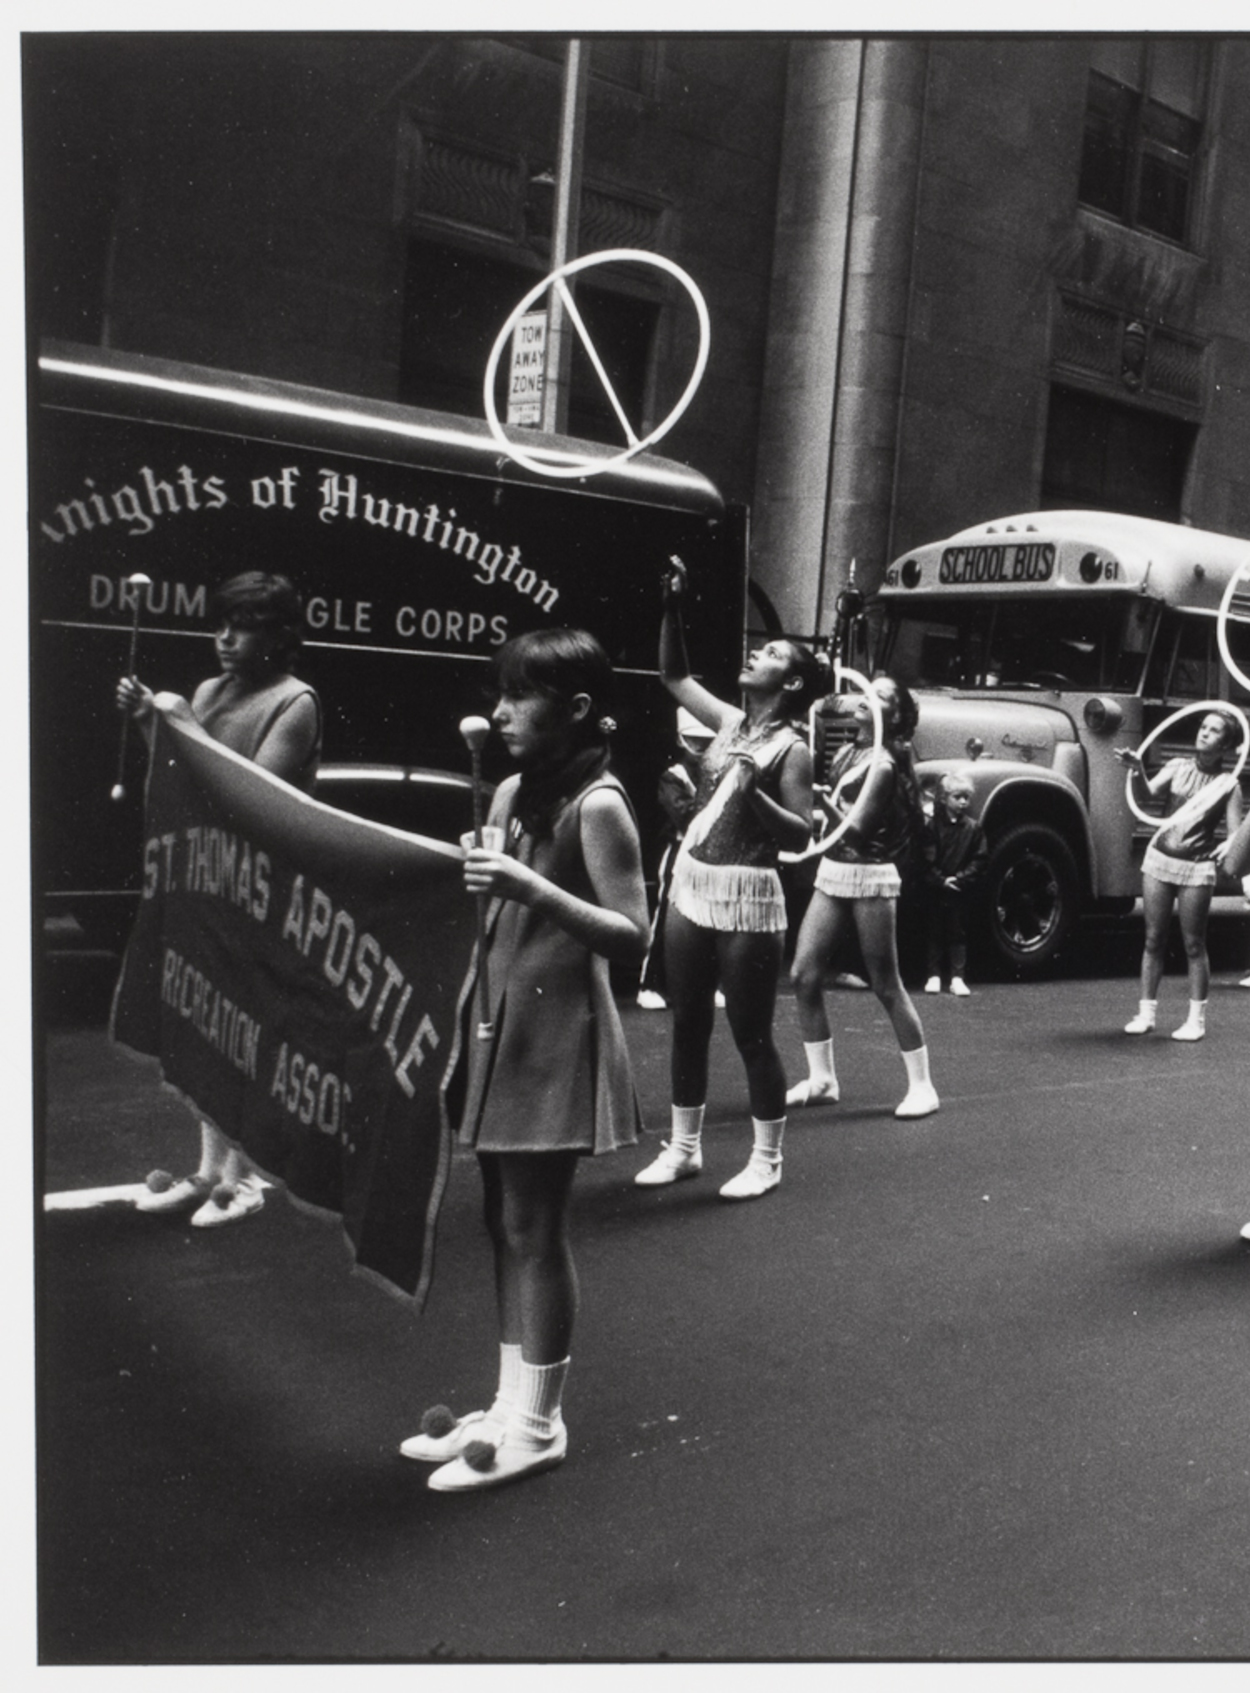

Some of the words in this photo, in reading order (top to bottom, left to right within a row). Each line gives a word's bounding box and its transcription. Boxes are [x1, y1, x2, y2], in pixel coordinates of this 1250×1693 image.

[521, 325, 542, 343] TOW
[514, 350, 544, 369] AWAY
[512, 375, 543, 394] ZONE
[41, 464, 228, 543] nights
[251, 466, 300, 510] of
[319, 468, 559, 613] Huntington
[941, 547, 1009, 581] SCHOOL
[1012, 544, 1053, 580] BUS
[1104, 561, 1119, 580] 61
[90, 574, 206, 617] DRUM
[306, 597, 372, 633] GLE
[395, 606, 508, 645] CORPS
[142, 834, 178, 900] ST.
[184, 826, 272, 923] THOMAS
[282, 874, 440, 1099] APOSTLE
